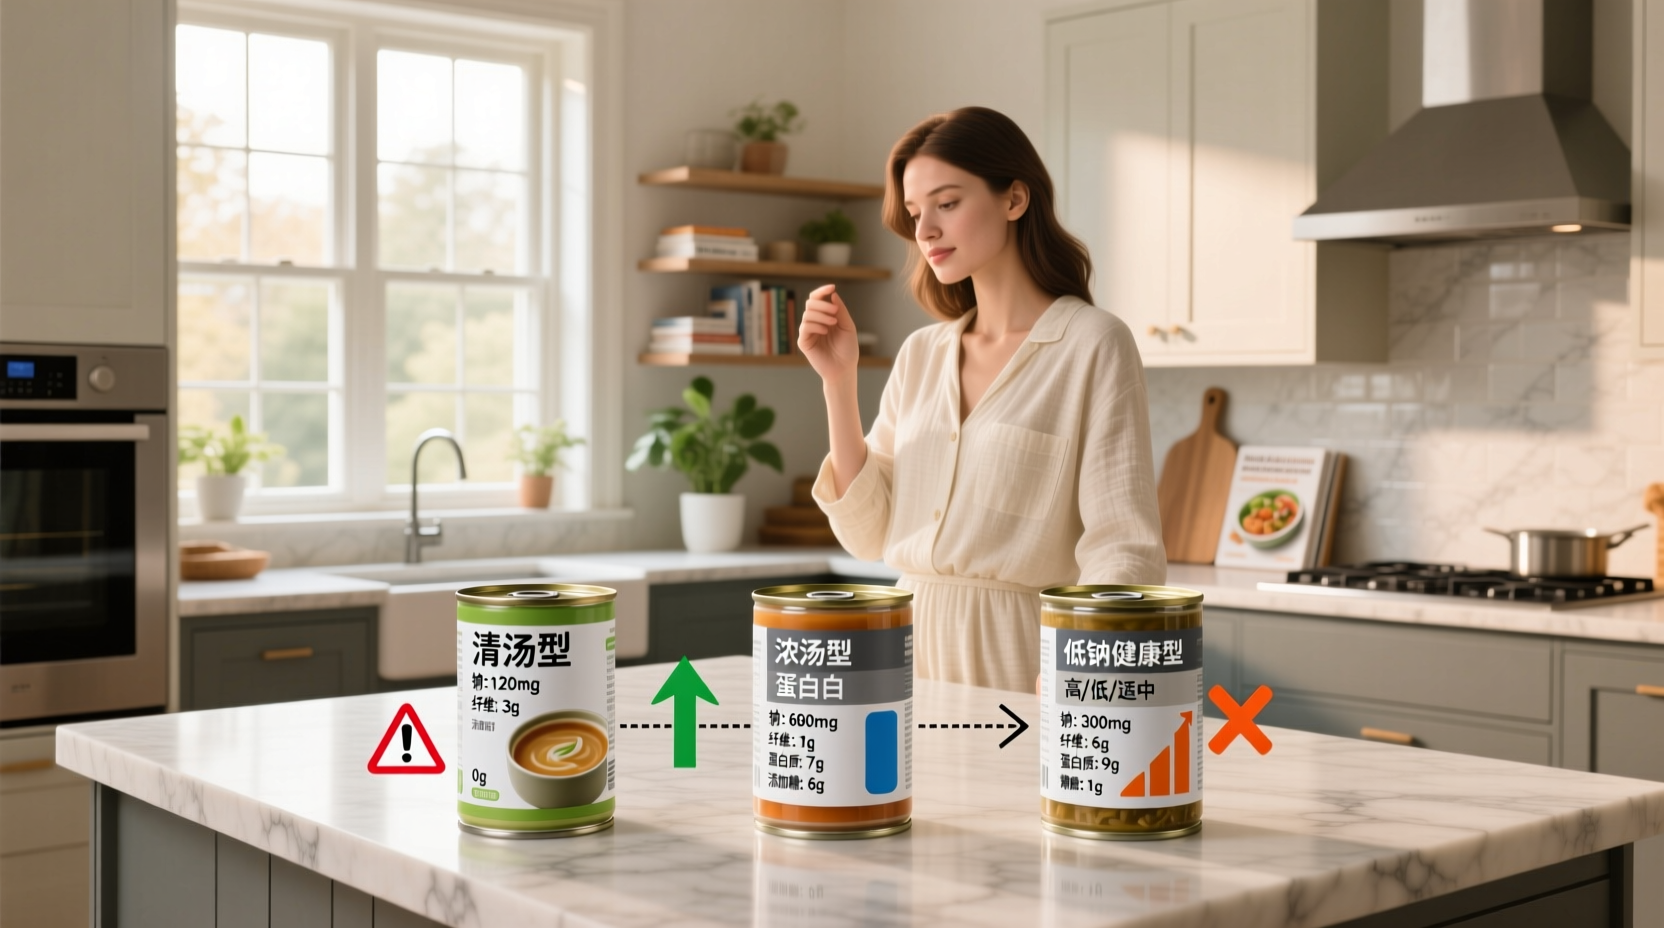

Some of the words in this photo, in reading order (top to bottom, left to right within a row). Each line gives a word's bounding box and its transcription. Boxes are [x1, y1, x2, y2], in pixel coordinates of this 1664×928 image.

[472, 631, 571, 668] 清汤型
[775, 637, 852, 667] 浓汤型
[1064, 638, 1183, 667] 低钠健康型
[775, 672, 843, 700] 蛋白白
[1064, 678, 1155, 702] 高/低/适中
[502, 700, 520, 717] 3g
[1081, 714, 1131, 734] 300mg
[800, 735, 815, 752] 1g
[1091, 736, 1109, 753] 6g
[806, 755, 824, 773] 7g
[1101, 757, 1120, 774] 9g
[472, 768, 487, 786] 0g
[807, 777, 825, 794] 6g
[1087, 779, 1103, 796] 1g
